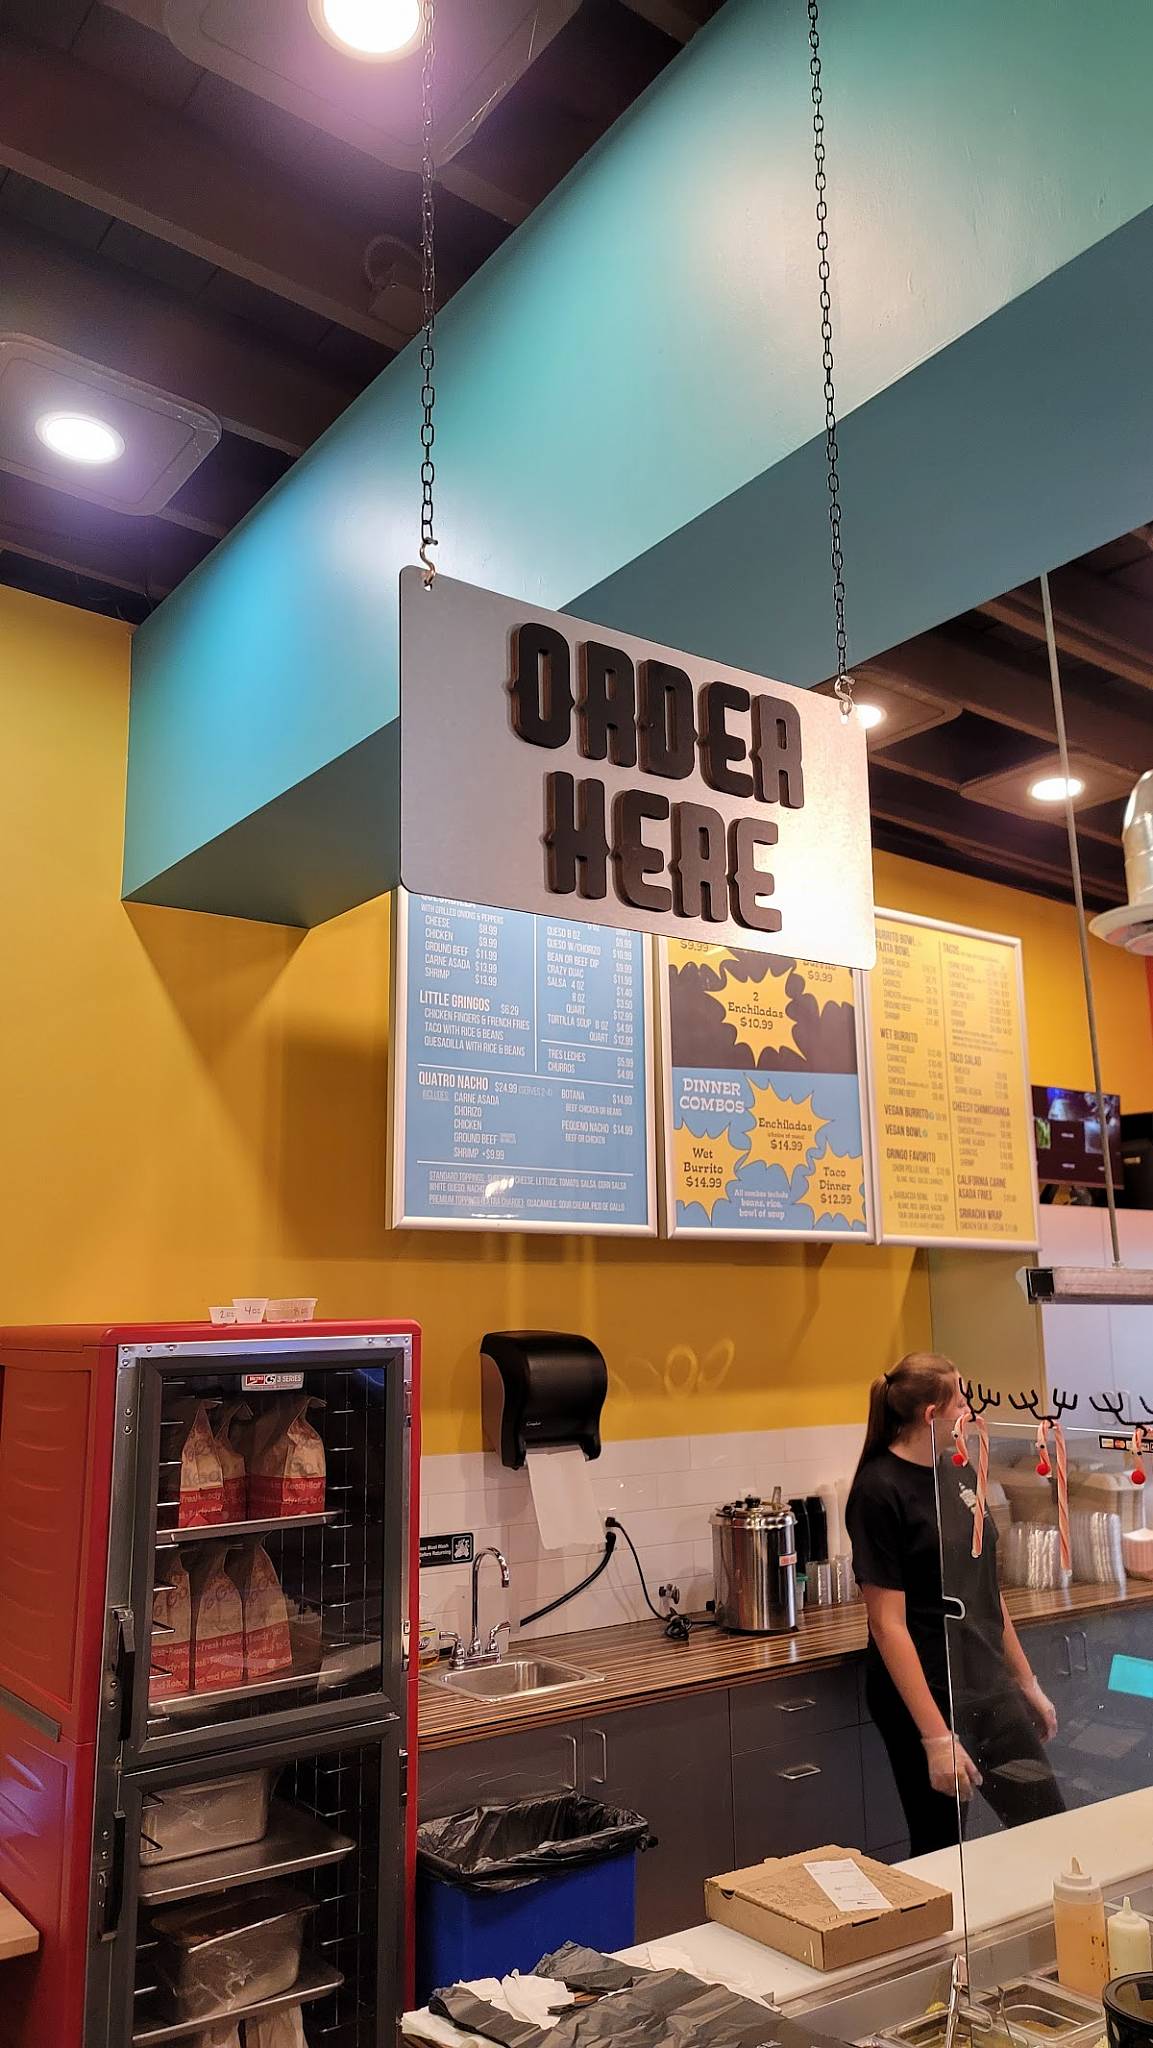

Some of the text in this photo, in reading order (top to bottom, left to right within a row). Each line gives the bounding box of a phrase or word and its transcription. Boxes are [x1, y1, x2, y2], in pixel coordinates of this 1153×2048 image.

[504, 623, 804, 809] ORDER
[541, 770, 782, 932] HERE
[480, 912, 504, 924] PEPPERS
[425, 915, 497, 935] CHEESE $8.99
[425, 927, 497, 948] CHICKEN $9.99
[546, 926, 566, 938] QUESO
[425, 940, 497, 960] GROUND BEEF $11.99
[546, 938, 566, 950] QUESO
[425, 954, 498, 974] CARNE ASADA $13.99
[547, 952, 563, 963] BEAN
[564, 954, 572, 964] OR
[574, 956, 588, 967] BEEF
[590, 958, 600, 968] DIP
[547, 964, 567, 976] CRAZY
[808, 970, 832, 982] $9.99
[425, 967, 497, 986] SHRIMP $13.99
[547, 976, 584, 991] SALSA 4 OZ
[420, 990, 450, 1006] LITTLE
[452, 994, 490, 1012] GRINGOS
[577, 993, 584, 1003] OZ
[752, 992, 758, 1000] 2
[566, 1004, 586, 1015] QUART
[728, 1002, 784, 1019] Enchiladas
[424, 1008, 452, 1021] CHICKEN
[454, 1011, 480, 1024] FINGERS
[488, 1015, 512, 1028] FRENCH
[512, 1018, 530, 1030] FRIES
[548, 1014, 575, 1026] TORTILLA
[576, 1017, 592, 1028] SOUP
[740, 1018, 774, 1030] $10.99
[424, 1022, 441, 1033] TACO
[442, 1024, 460, 1036] WITH
[460, 1026, 475, 1038] RICE
[482, 1028, 504, 1041] BEANS
[590, 1032, 608, 1043] QUART
[880, 1027, 892, 1040] WET
[424, 1036, 464, 1050] QUESADILLA
[465, 1040, 482, 1052] WITH
[483, 1041, 498, 1054] RICE
[504, 1045, 526, 1057] BEANS
[548, 1048, 563, 1060] TRES
[564, 1050, 586, 1062] LECHES
[548, 1062, 576, 1074] CHURROS
[419, 1072, 518, 1094] QUATRO NACHO $24.99
[682, 1078, 741, 1096] DINNER
[454, 1092, 500, 1105] CARNE ASADA
[562, 1088, 584, 1100] BOTANA
[680, 1096, 745, 1114] COMBOS
[454, 1105, 482, 1118] CHORIZO
[884, 1104, 904, 1116] VEGAN
[904, 1107, 928, 1120] BURRITO
[454, 1119, 482, 1131] CHICKEN
[590, 1122, 609, 1134] NACHO
[758, 1118, 812, 1132] Enchiladas
[885, 1124, 905, 1136] VEGAN
[906, 1126, 922, 1138] BOWL
[454, 1132, 480, 1144] GROUND
[482, 1134, 498, 1144] BEEF
[770, 1140, 802, 1152] $14.99
[454, 1147, 479, 1158] SHRIMP
[692, 1148, 713, 1159] Wet
[886, 1148, 908, 1160] GRINGO
[684, 1162, 724, 1174] Burrito
[823, 1166, 846, 1178] Taco
[686, 1176, 722, 1188] $14.99
[819, 1180, 852, 1191] Dinner
[820, 1193, 852, 1204] $12.99
[739, 1209, 756, 1218] bowl
[758, 1210, 766, 1218] of
[220, 1310, 224, 1318] 2
[244, 1306, 252, 1314] 4
